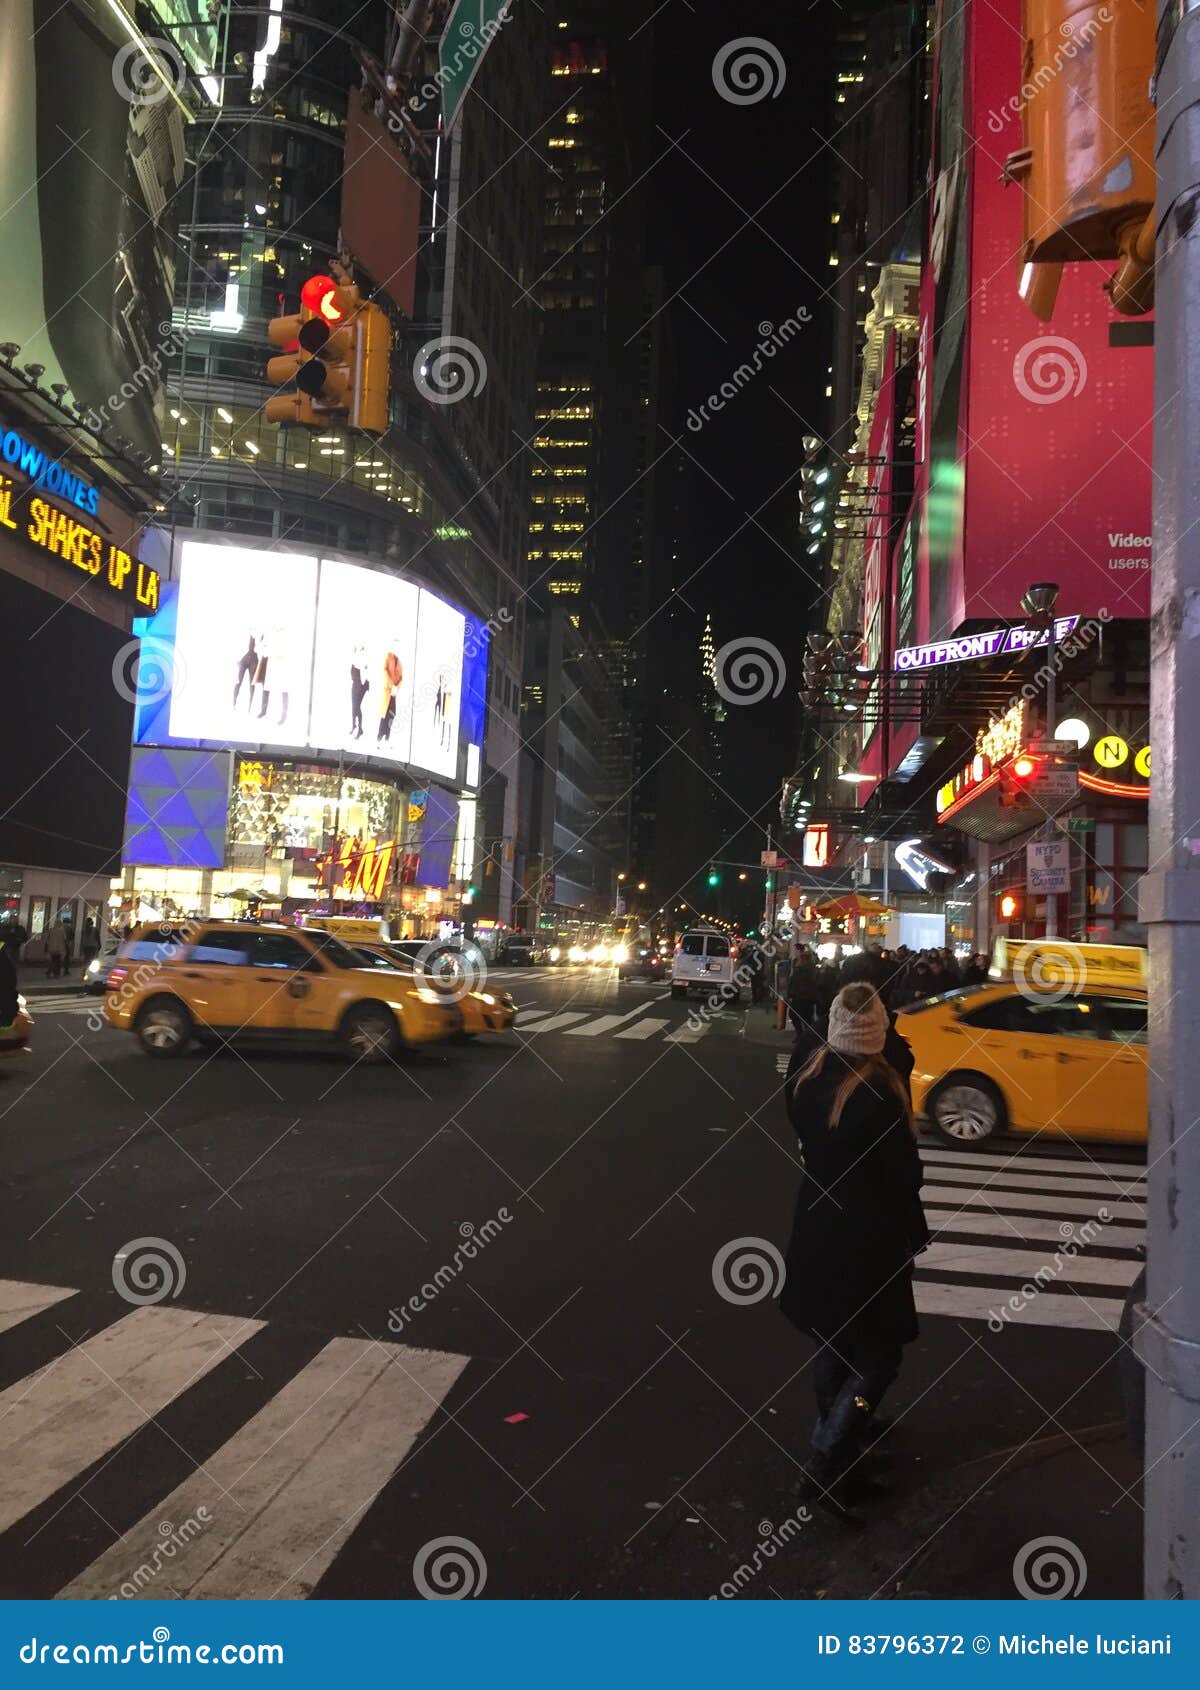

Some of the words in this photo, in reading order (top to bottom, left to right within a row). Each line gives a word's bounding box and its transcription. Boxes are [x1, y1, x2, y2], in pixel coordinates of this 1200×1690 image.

[28, 498, 102, 575] SHAKES
[108, 546, 131, 589] UP
[136, 564, 157, 609] LA
[1108, 533, 1152, 548] Video
[1108, 558, 1149, 570] users
[899, 633, 1001, 669] OUTFRONT
[1010, 620, 1072, 649] PRE
